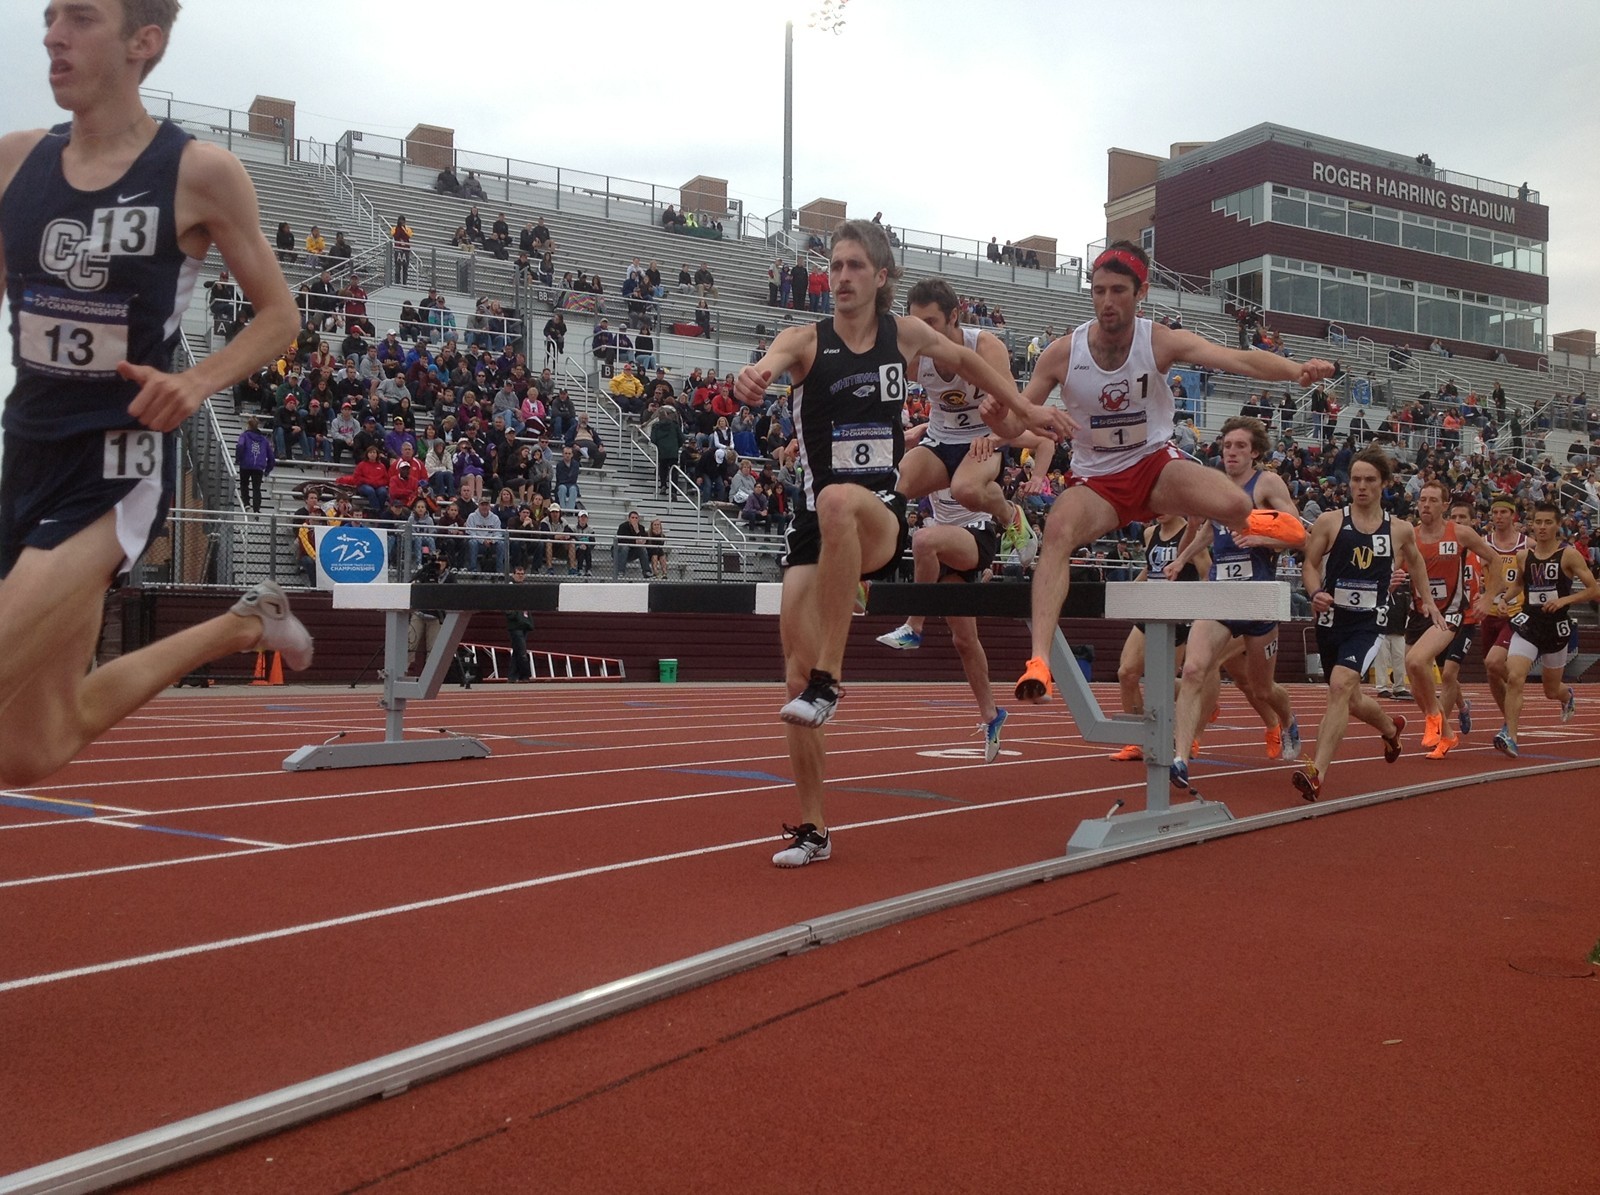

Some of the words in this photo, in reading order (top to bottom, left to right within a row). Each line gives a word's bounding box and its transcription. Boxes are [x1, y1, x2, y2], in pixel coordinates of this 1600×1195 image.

[1313, 161, 1371, 192] ROGER
[1376, 176, 1447, 209] HARRING
[1451, 193, 1516, 224] STADIUM
[97, 208, 148, 254] 13
[396, 252, 407, 263] AA
[538, 291, 548, 301] BB
[47, 301, 128, 317] CHAMPIONSHIPS
[217, 321, 227, 333] A
[45, 324, 94, 366] 13
[604, 366, 611, 377] B
[886, 366, 900, 399] 8
[1136, 373, 1148, 399] 1
[957, 413, 970, 427] 2
[1114, 429, 1124, 445] 1
[110, 432, 156, 477] 13
[855, 443, 870, 466] 8
[1376, 536, 1387, 556] 3
[1442, 542, 1455, 554] 14
[1225, 564, 1242, 578] 12
[1507, 569, 1517, 582] 9
[1546, 564, 1557, 579] 6
[1350, 592, 1361, 606] 3
[1539, 592, 1547, 603] 6
[1559, 621, 1569, 636] 6
[1266, 640, 1277, 657] 12
